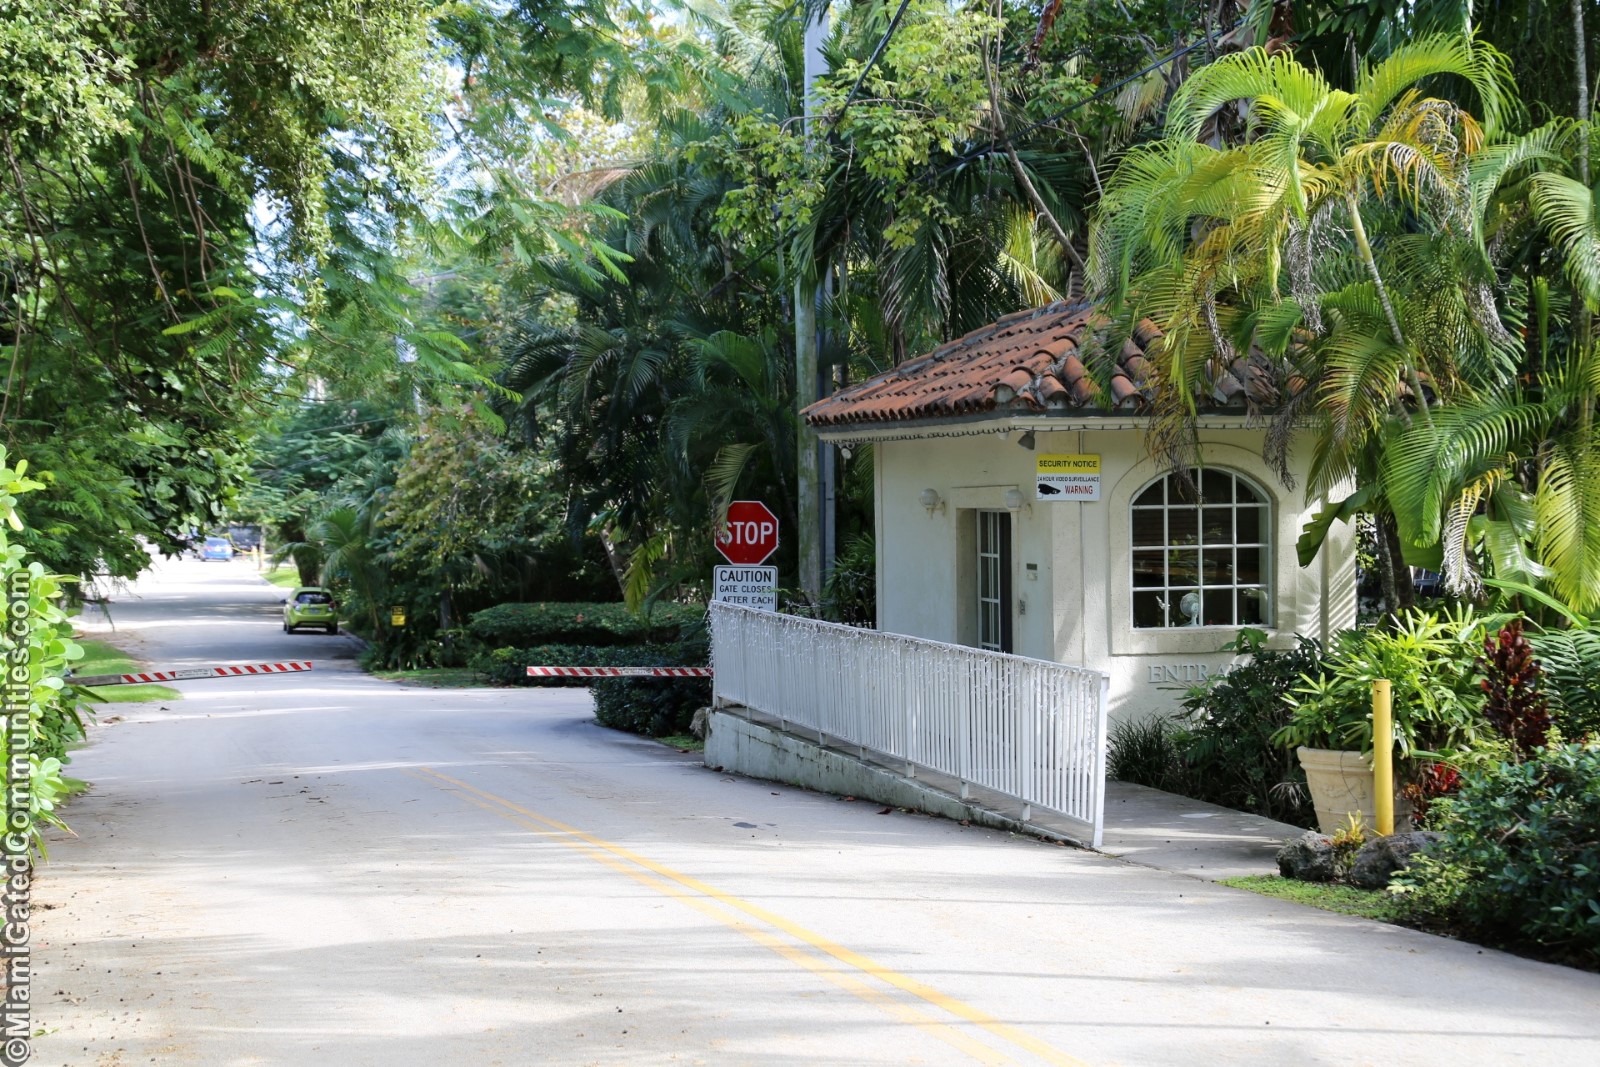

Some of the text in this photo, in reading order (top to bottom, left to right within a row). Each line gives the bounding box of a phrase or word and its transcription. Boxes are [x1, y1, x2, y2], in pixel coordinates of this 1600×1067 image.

[1065, 485, 1093, 494] WARNING
[719, 521, 773, 545] STOP
[720, 570, 772, 582] CAUTION
[720, 584, 772, 593] GATE CLOSES
[722, 595, 773, 604] AFTER EACH
